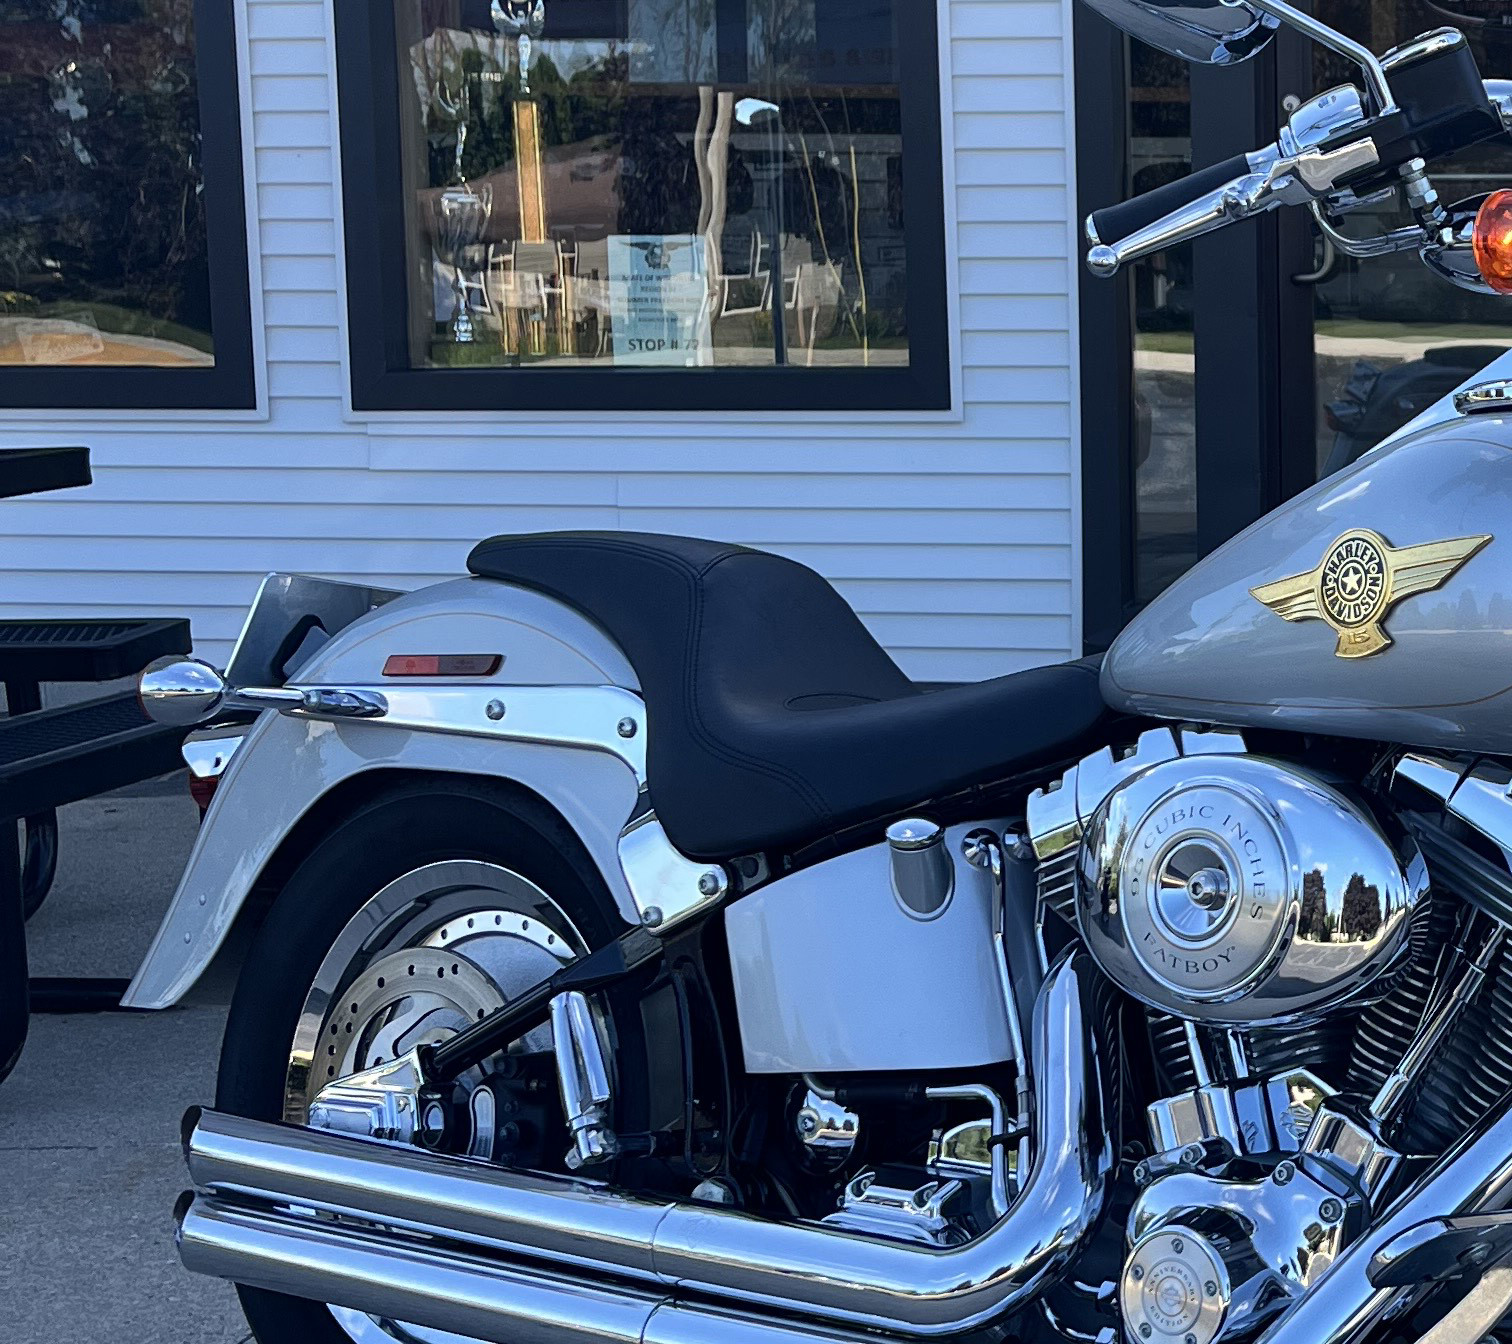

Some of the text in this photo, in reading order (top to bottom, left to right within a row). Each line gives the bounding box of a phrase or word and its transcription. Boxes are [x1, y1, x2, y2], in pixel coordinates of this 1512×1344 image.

[628, 338, 666, 351] STOP
[1326, 540, 1379, 577] HARLEY
[1323, 573, 1382, 621] DAVIDSON
[1348, 629, 1371, 645] 15
[1144, 805, 1214, 850] CUBIC
[1222, 814, 1266, 920] INCHES
[1148, 1266, 1195, 1302] ANNIVERSARY
[1150, 1305, 1188, 1327] EDITION
